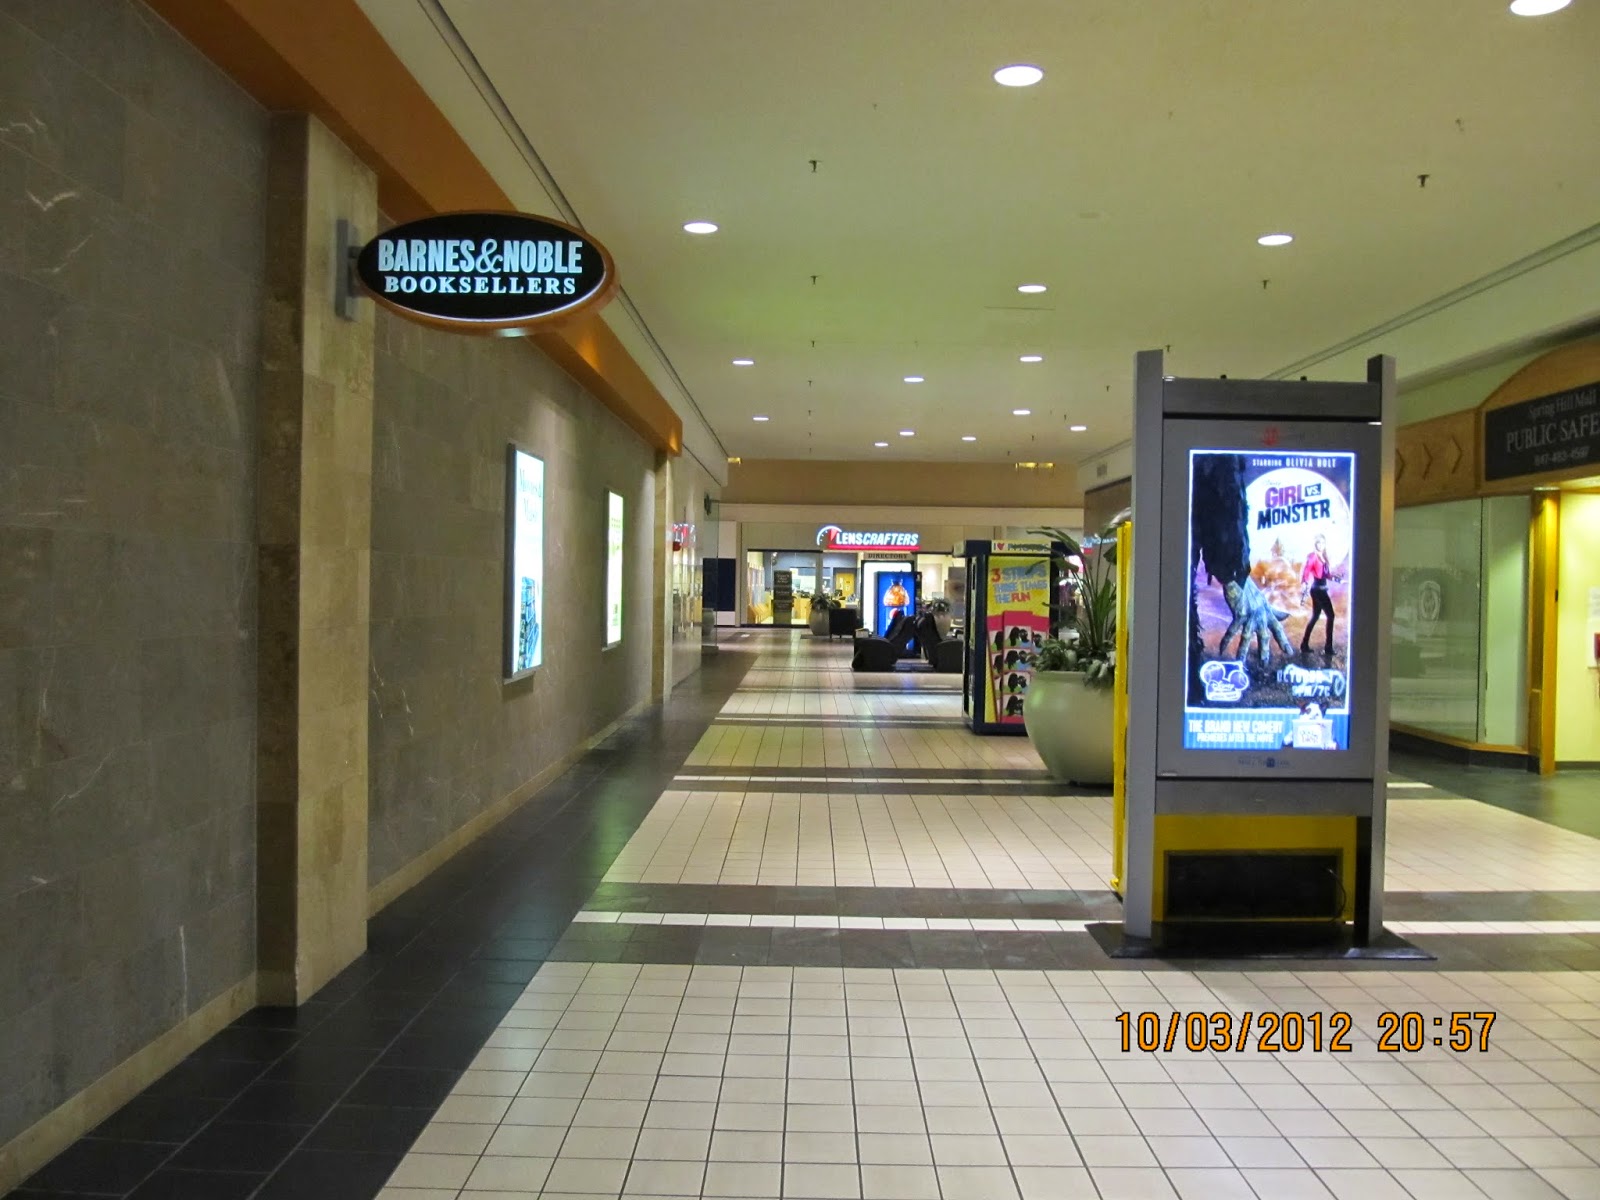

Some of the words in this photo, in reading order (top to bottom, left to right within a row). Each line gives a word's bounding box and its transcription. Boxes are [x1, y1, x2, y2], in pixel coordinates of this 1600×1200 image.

[384, 276, 576, 295] BOOKSELLERS
[1505, 422, 1557, 453] PUBLIC
[1559, 411, 1600, 442] SAFE
[1285, 457, 1313, 468] OLIVIA
[1316, 458, 1337, 469] HOLT
[1264, 484, 1306, 509] GIRL
[1305, 484, 1321, 497] VS.
[1256, 498, 1331, 531] MONSTER
[836, 532, 919, 546] LENSCRAFTERS
[991, 567, 1001, 582] 3
[1011, 591, 1031, 603] FUN
